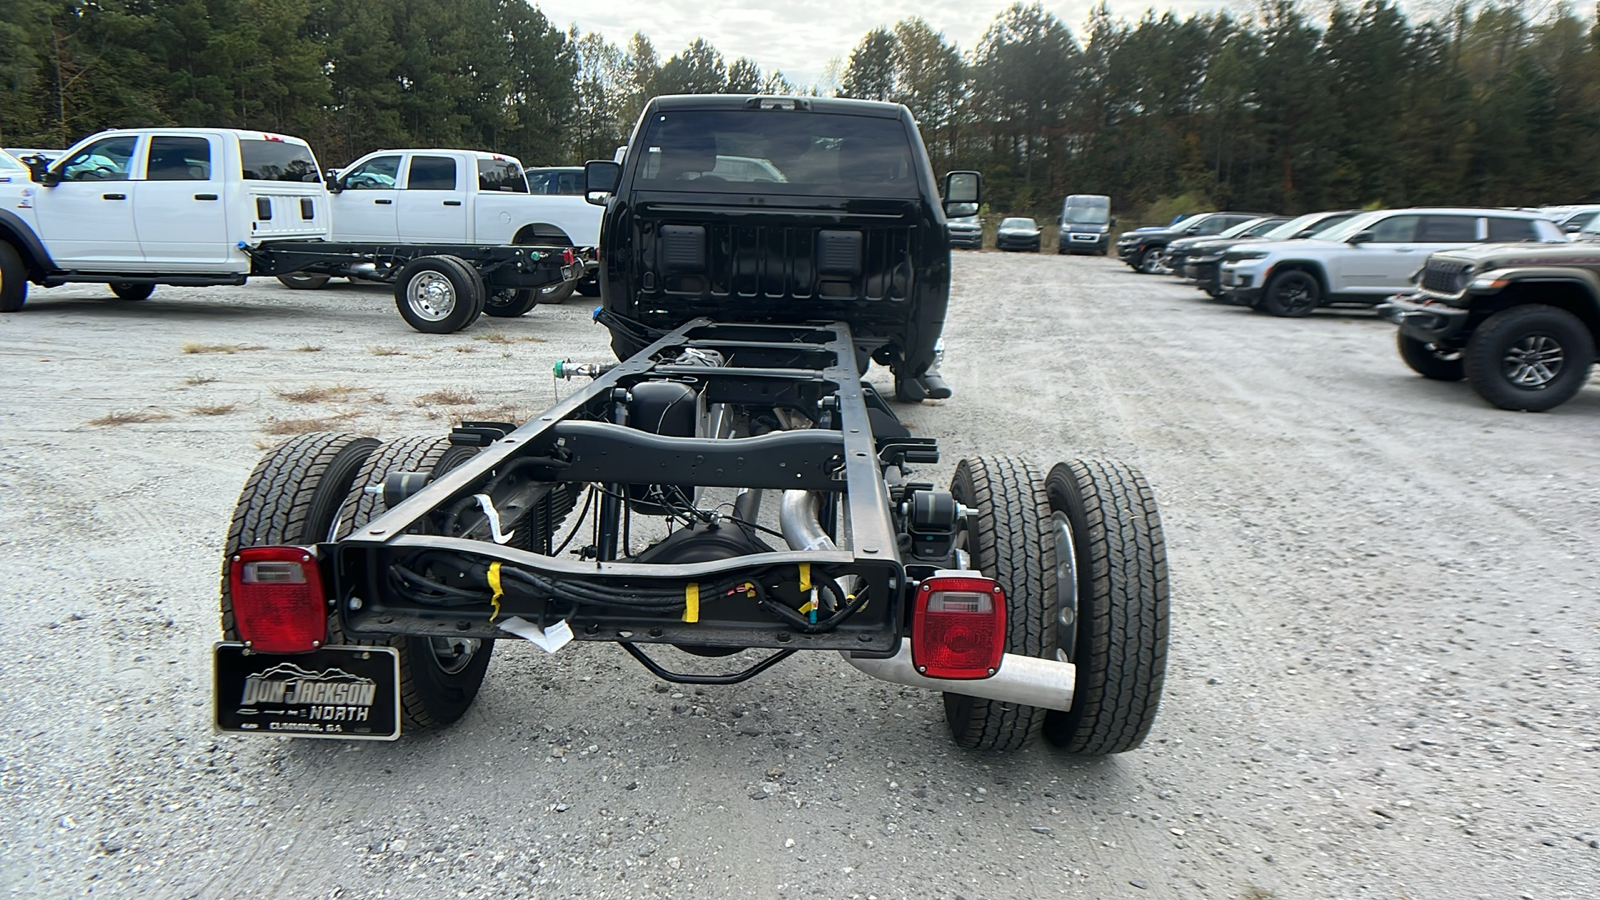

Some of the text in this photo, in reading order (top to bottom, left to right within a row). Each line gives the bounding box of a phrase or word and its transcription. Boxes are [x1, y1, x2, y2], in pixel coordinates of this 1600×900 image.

[240, 678, 377, 706] DON JACKSON
[309, 705, 369, 722] NORTH
